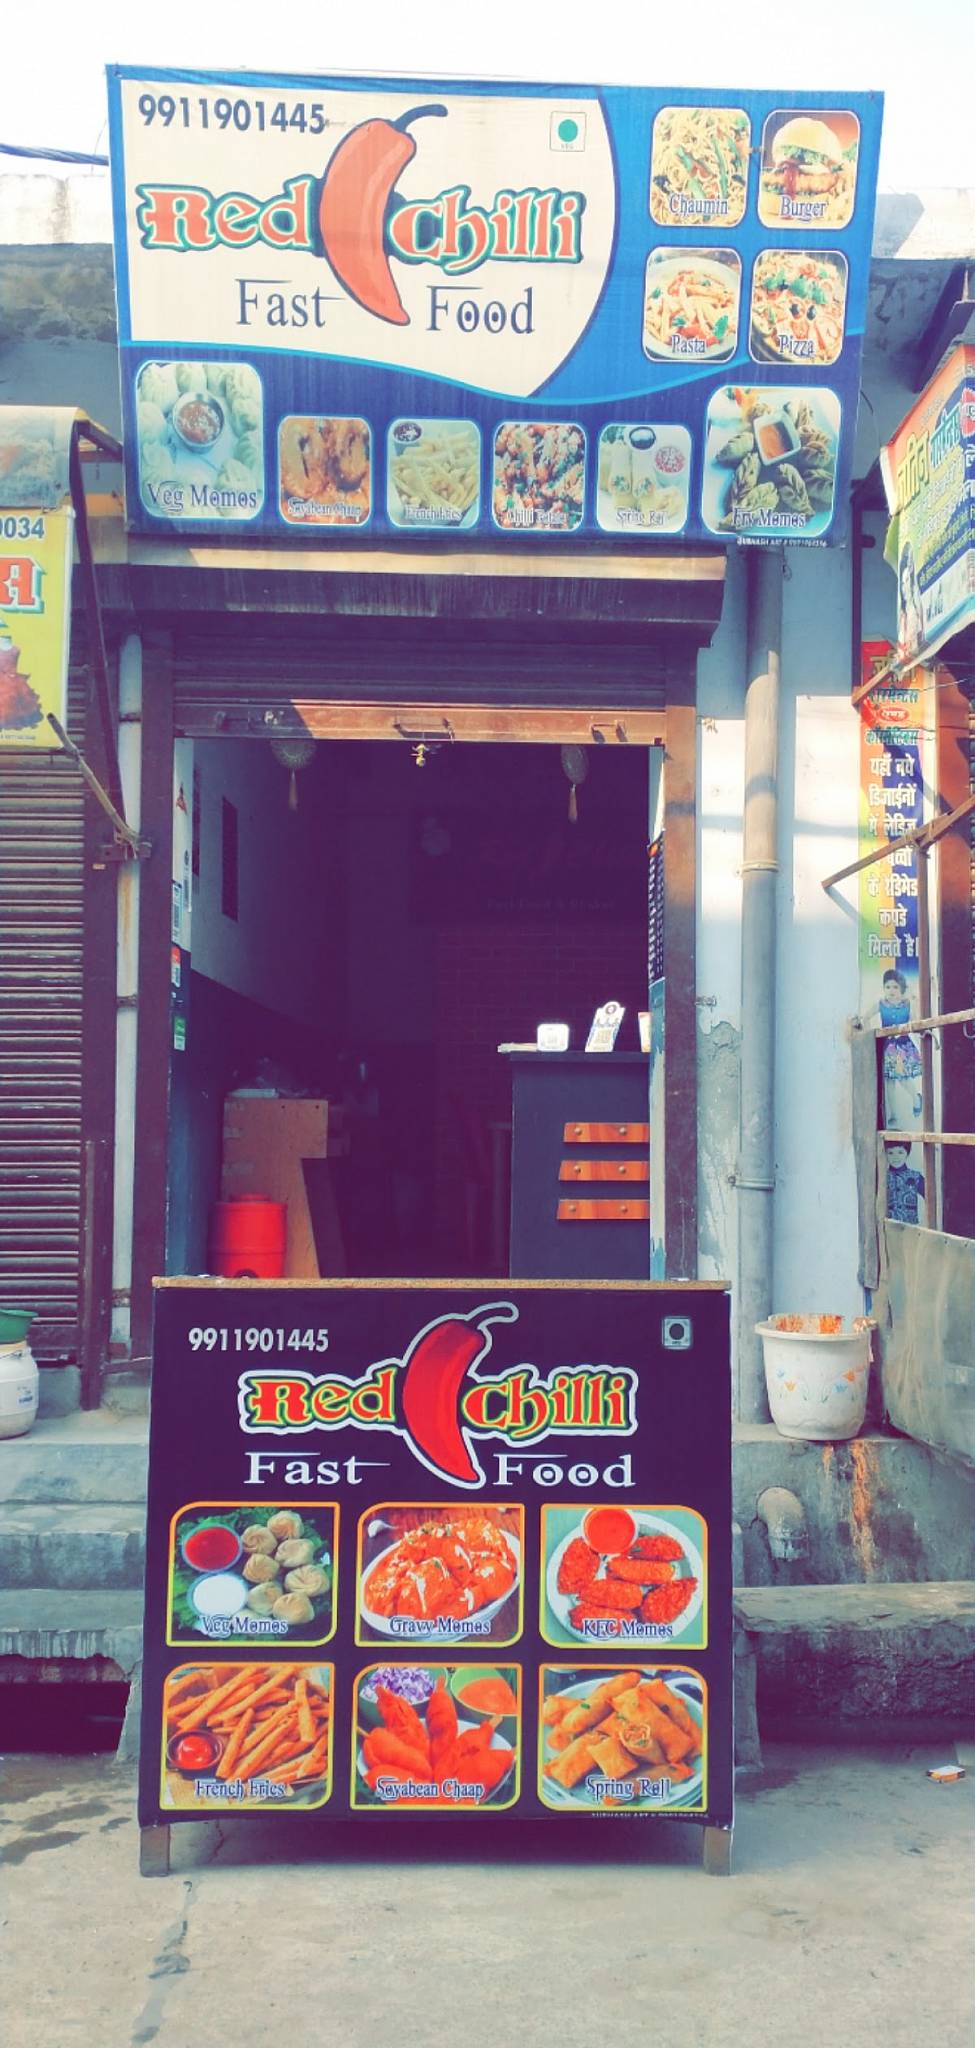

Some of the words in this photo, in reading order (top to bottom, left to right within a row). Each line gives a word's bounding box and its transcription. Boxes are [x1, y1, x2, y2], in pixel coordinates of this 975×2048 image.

[138, 94, 325, 134] 9911901445
[669, 193, 729, 216] Chaumin
[780, 195, 829, 221] Burger
[137, 176, 315, 250] Red
[388, 186, 582, 272] Chilli
[235, 279, 340, 327] Fast
[426, 285, 535, 334] Food
[671, 334, 706, 354] Pasta
[778, 334, 815, 358] Pizza
[147, 480, 184, 512] Veg
[190, 484, 258, 507] Momos
[189, 1326, 329, 1352] 9911901445
[248, 1367, 397, 1426] Red
[461, 1371, 628, 1439] Chilli
[243, 1451, 388, 1485] Fast
[492, 1453, 637, 1488] Food
[201, 1614, 232, 1638] Veg
[234, 1616, 289, 1634] Momos
[389, 1616, 434, 1640] Gravy
[437, 1617, 492, 1634] Momos
[582, 1618, 617, 1640] KFC
[621, 1619, 673, 1637] Momos
[195, 1778, 245, 1799] French
[249, 1778, 286, 1798] Fries
[376, 1777, 438, 1801] Soyabean
[442, 1779, 484, 1802] Chaap
[585, 1776, 633, 1800] Spring
[639, 1777, 671, 1800] Roll
